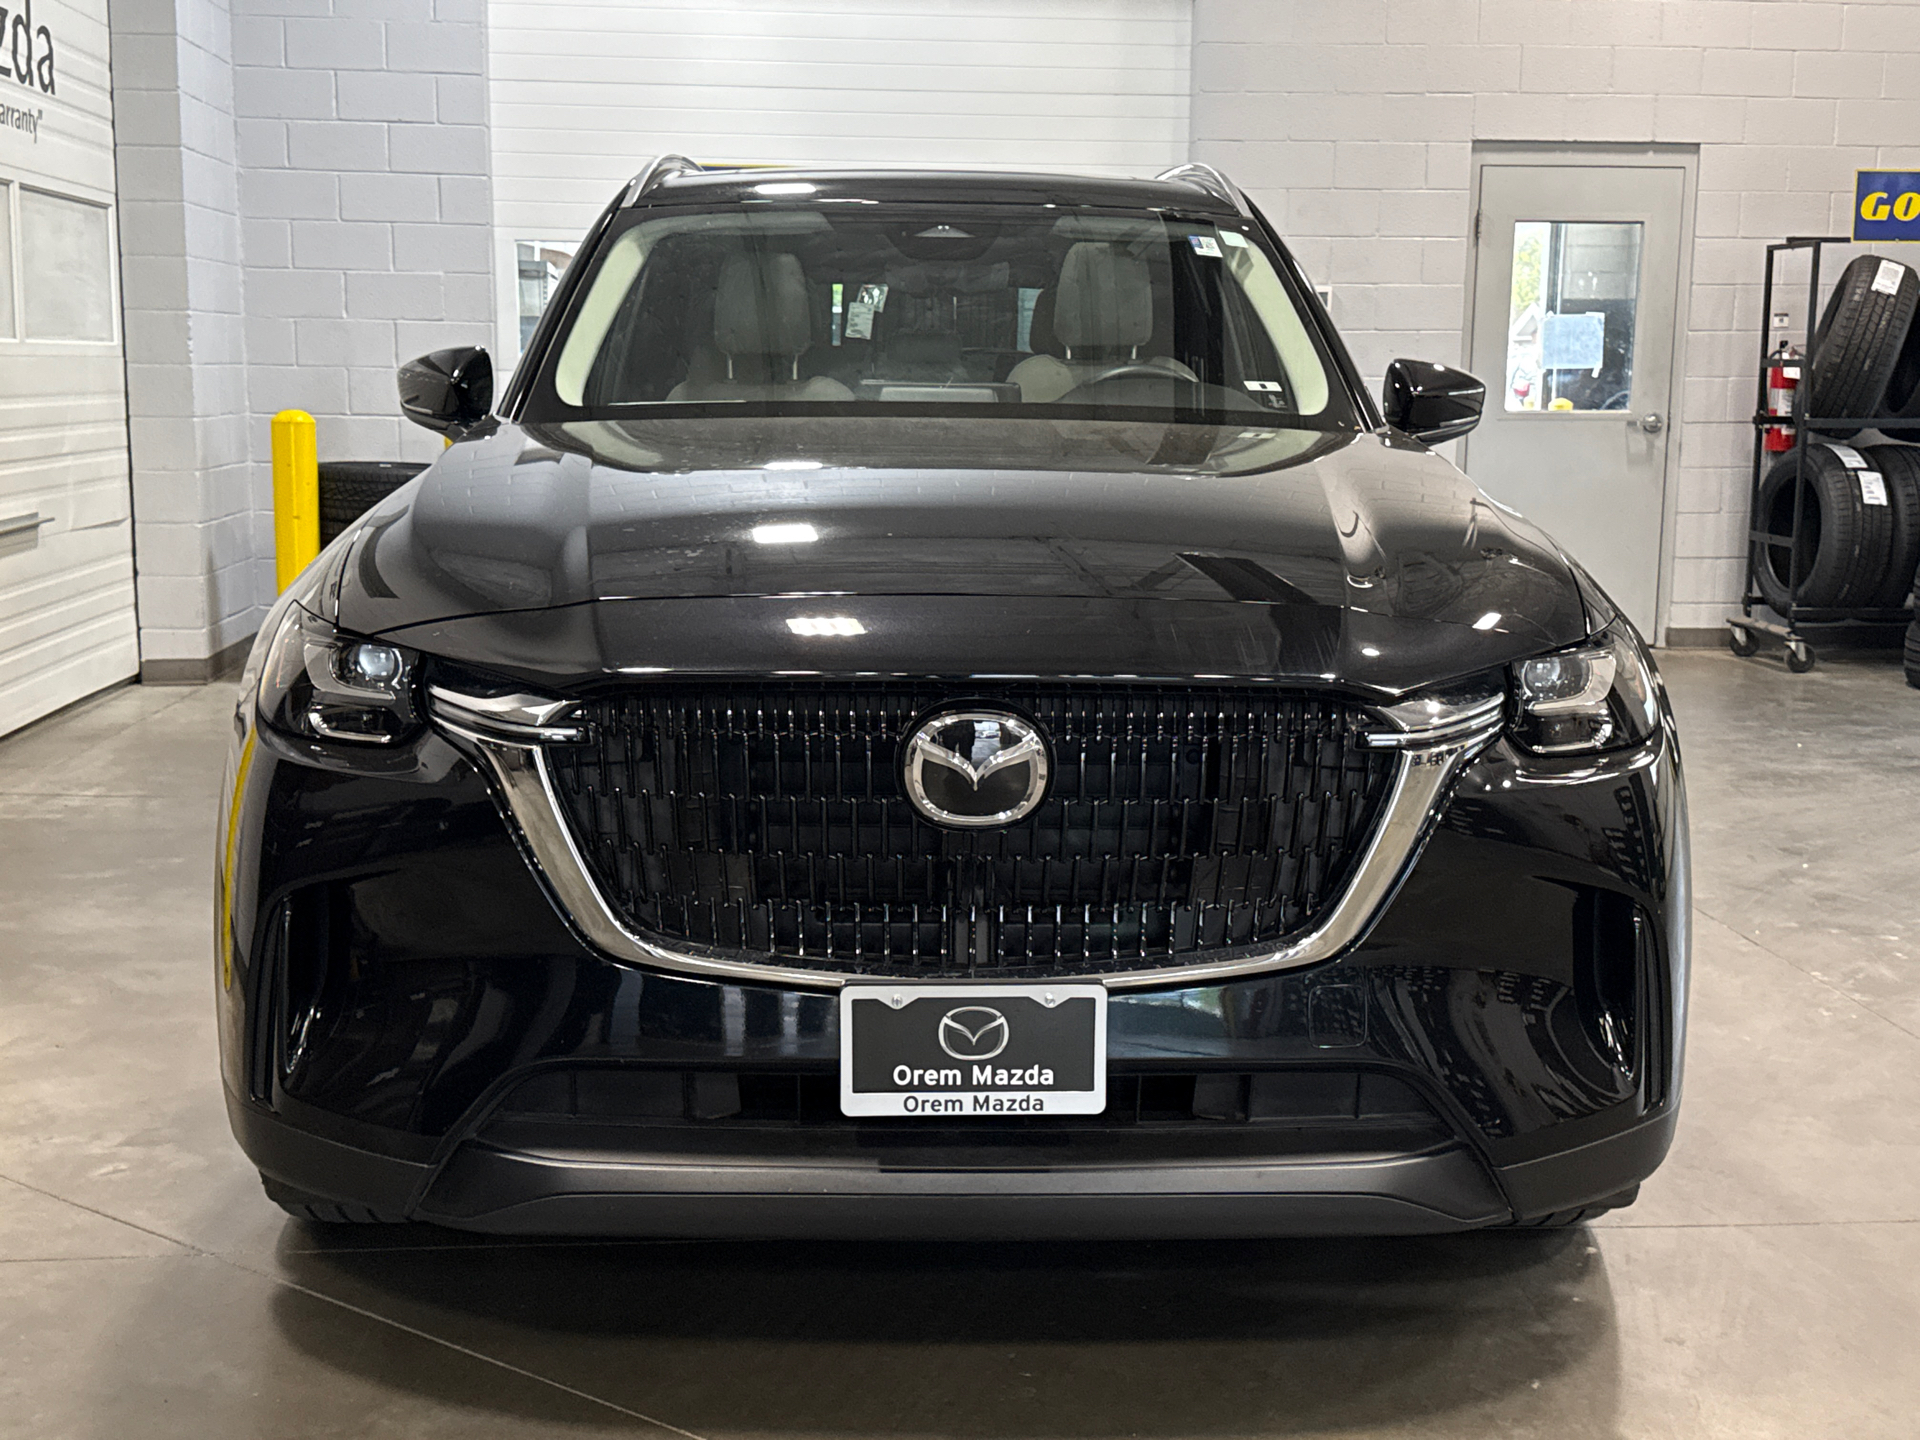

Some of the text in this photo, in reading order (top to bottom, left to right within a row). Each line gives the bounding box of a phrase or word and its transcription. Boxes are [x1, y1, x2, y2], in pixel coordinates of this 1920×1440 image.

[0, 0, 56, 95] zda
[1860, 191, 1920, 221] GO
[893, 1064, 1054, 1086] Orem Mazda
[903, 1095, 1044, 1113] Orem Mazda
